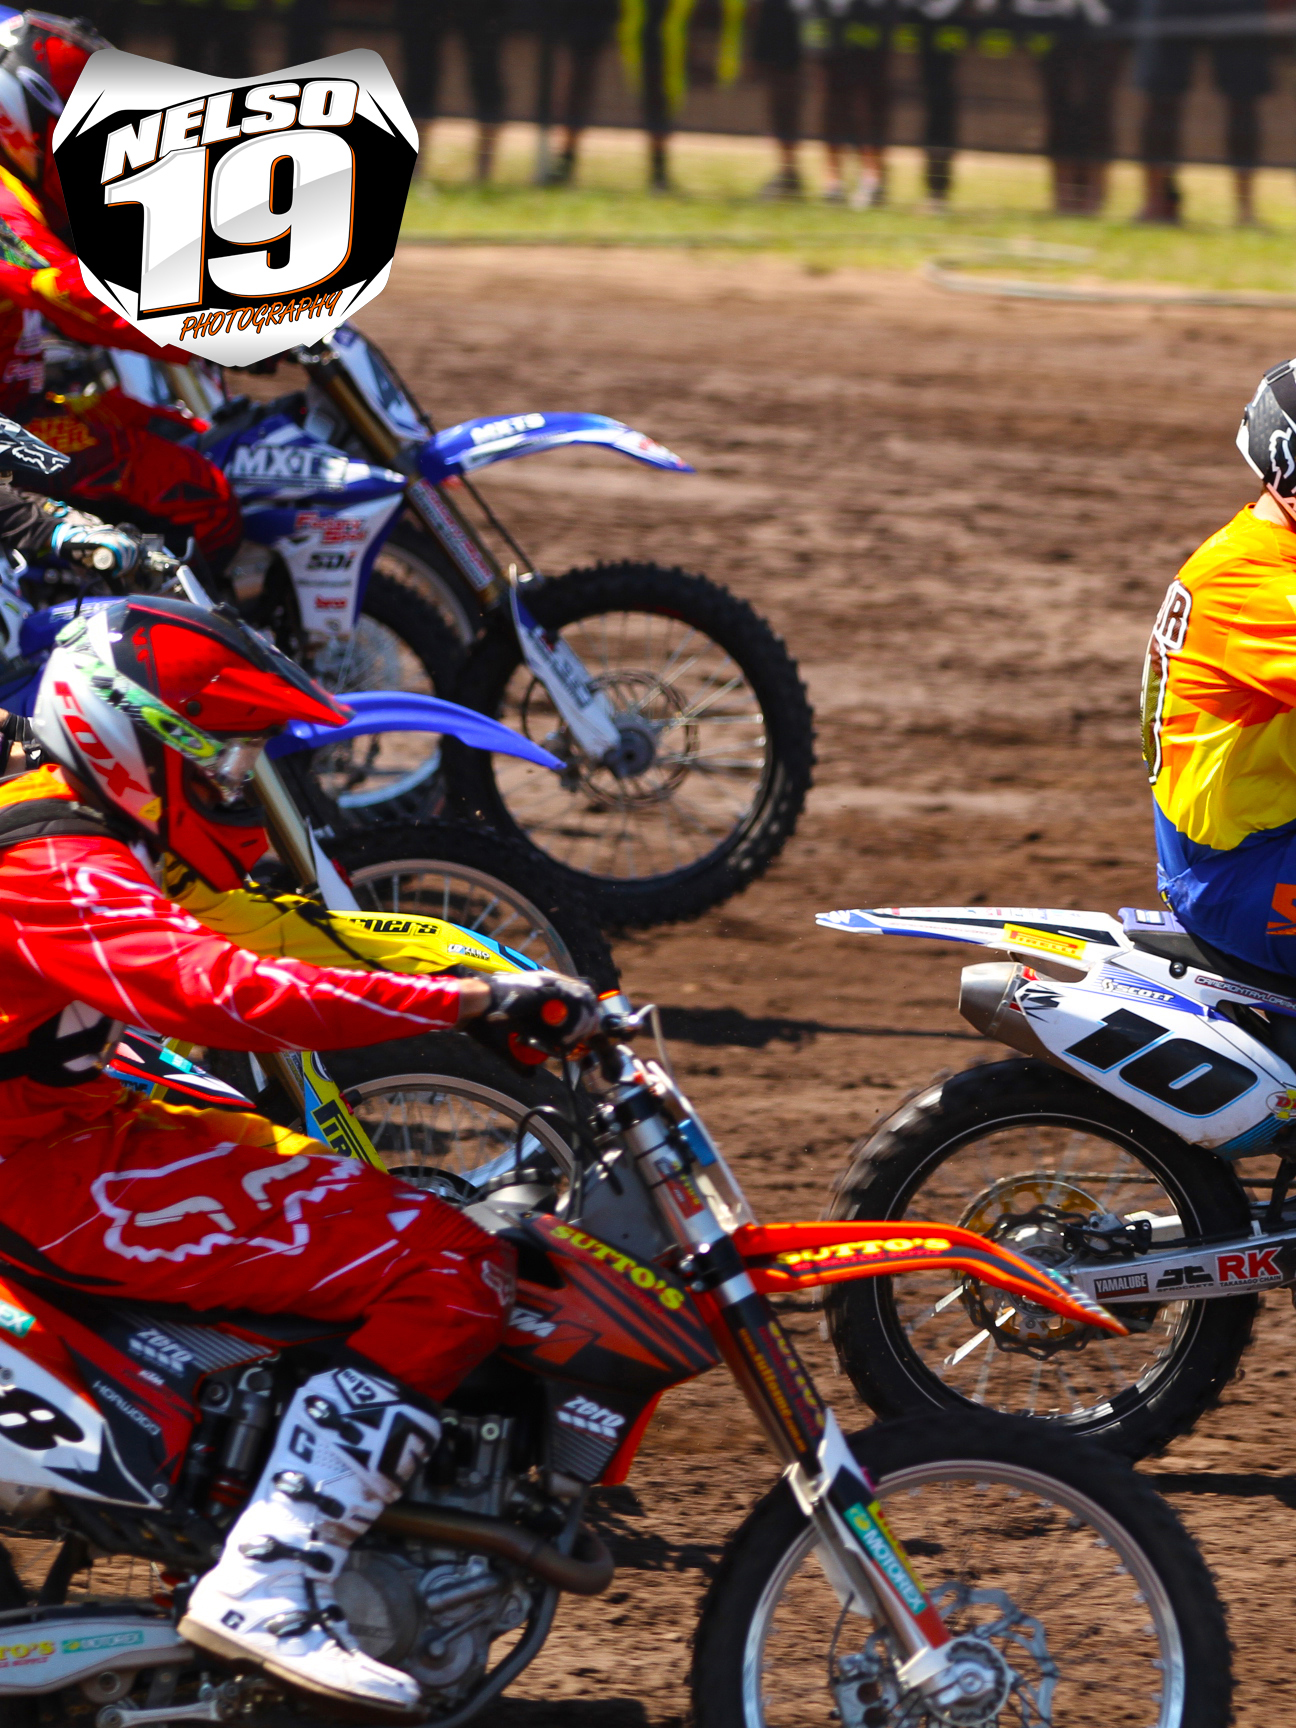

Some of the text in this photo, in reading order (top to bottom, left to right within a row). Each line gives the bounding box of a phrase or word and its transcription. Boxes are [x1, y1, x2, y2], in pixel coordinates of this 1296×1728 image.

[53, 680, 150, 798] FOX
[1115, 983, 1175, 1003] SCOTT
[1063, 1007, 1260, 1119] 10
[550, 1224, 686, 1310] SUTTO'S
[1216, 1247, 1284, 1283] RK
[1096, 1274, 1147, 1294] YAMALUBE
[1156, 1282, 1215, 1293] SPROCKETS
[1219, 1274, 1282, 1288] TAKASAGO CHAIN
